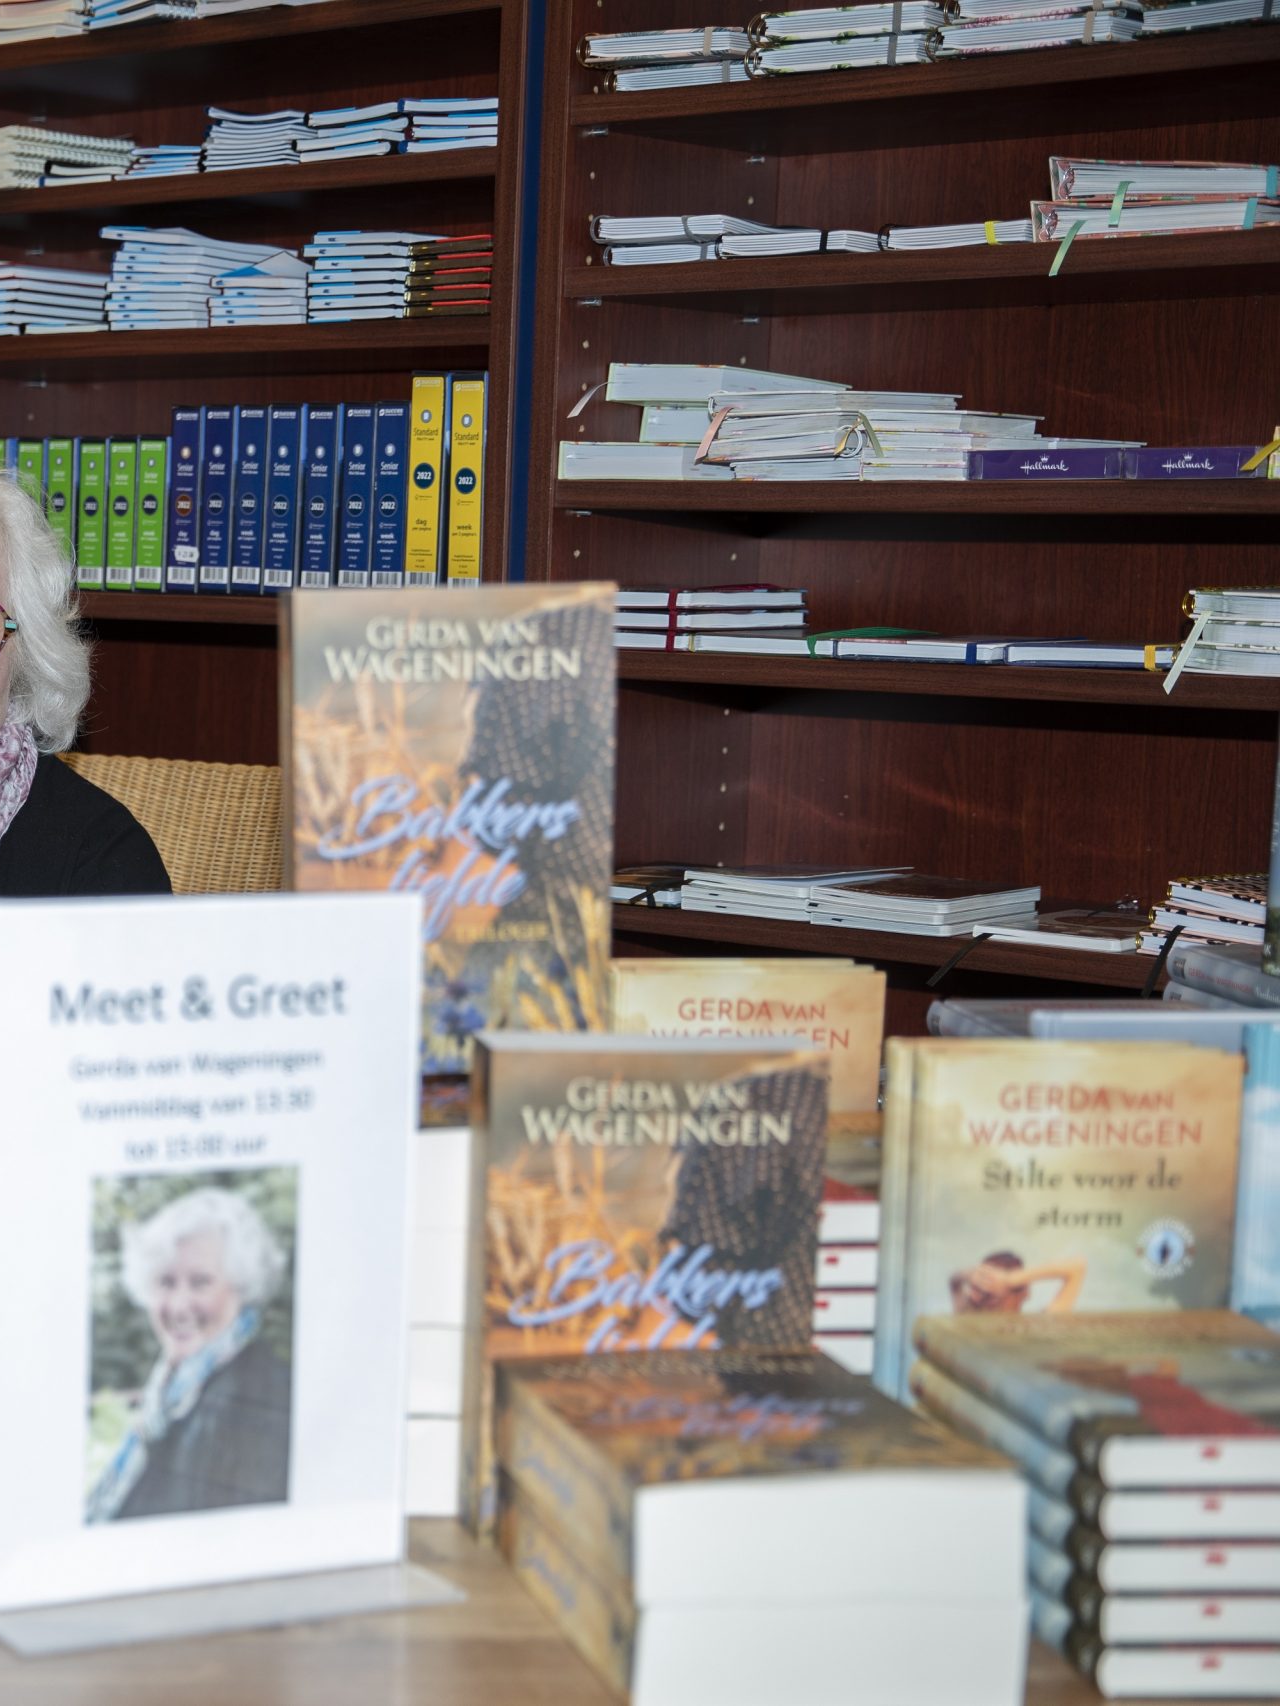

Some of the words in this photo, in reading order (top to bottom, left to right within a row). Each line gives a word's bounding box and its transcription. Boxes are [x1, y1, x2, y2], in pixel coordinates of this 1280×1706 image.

[414, 427, 438, 437] Standard
[454, 432, 479, 441] Standard
[177, 462, 193, 471] Senior
[209, 462, 225, 470] Senior
[242, 461, 259, 470] Senior
[274, 463, 291, 471] Senior
[311, 463, 328, 472] Senior
[349, 461, 366, 470] Senior
[381, 461, 398, 470] Senior
[1020, 459, 1069, 475] Hallmark
[1162, 458, 1214, 474] Hallmark
[417, 472, 431, 480] 2022
[458, 476, 473, 485] 2022
[177, 501, 190, 509] 2022
[209, 500, 222, 508] 2022
[242, 499, 255, 507] 2022
[273, 501, 287, 509] 2022
[311, 502, 324, 510] 2022
[348, 501, 362, 509] 2022
[381, 501, 395, 510] 2022
[415, 518, 427, 527] dag
[366, 616, 472, 650] GERDA
[477, 618, 540, 646] VAN
[323, 645, 581, 682] WAGENINGEN
[317, 774, 581, 859] Bakkers
[49, 982, 166, 1026] Meet
[180, 974, 215, 1021] &
[227, 973, 348, 1020] Greet
[678, 998, 773, 1022] GERDA
[782, 1002, 827, 1020] VAN
[71, 1056, 139, 1079] Gerda
[146, 1058, 182, 1075] van
[192, 1049, 324, 1076] Wageningen
[566, 1077, 677, 1112] GERDA
[683, 1080, 749, 1108] VAN
[1000, 1084, 1111, 1113] GERDA
[1122, 1088, 1175, 1110] VAN
[211, 1095, 247, 1113] van
[521, 1105, 793, 1146] WAGENINGEN
[968, 1119, 1202, 1147] WAGENINGEN
[125, 1139, 158, 1161] tot
[232, 1136, 267, 1157] uur
[983, 1156, 1063, 1191] Stilte
[1073, 1172, 1138, 1189] voor
[1148, 1156, 1183, 1190] de
[1037, 1207, 1123, 1228] storm
[508, 1239, 785, 1325] Bakkers
